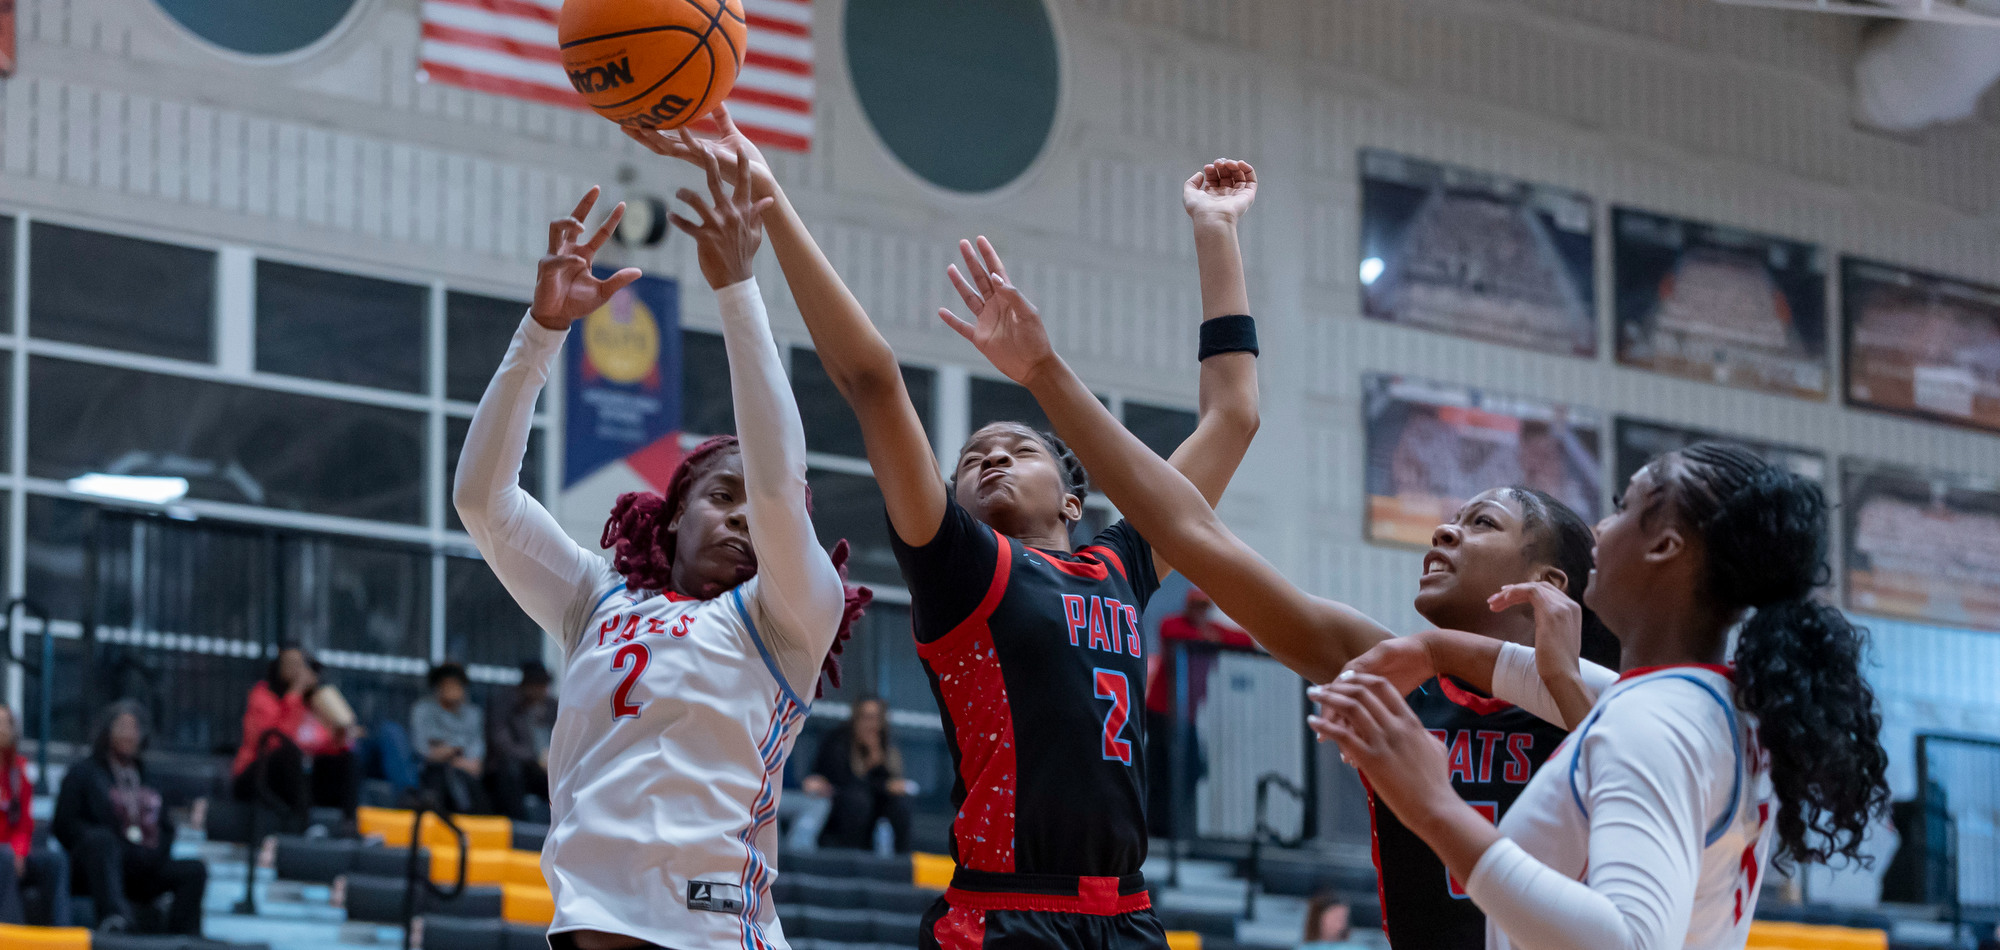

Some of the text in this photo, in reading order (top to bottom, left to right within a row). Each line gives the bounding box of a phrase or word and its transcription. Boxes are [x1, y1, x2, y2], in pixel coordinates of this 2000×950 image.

[1061, 593, 1141, 658] PATS
[610, 640, 652, 722] 2
[1092, 666, 1132, 767] 2
[723, 900, 734, 909] M
